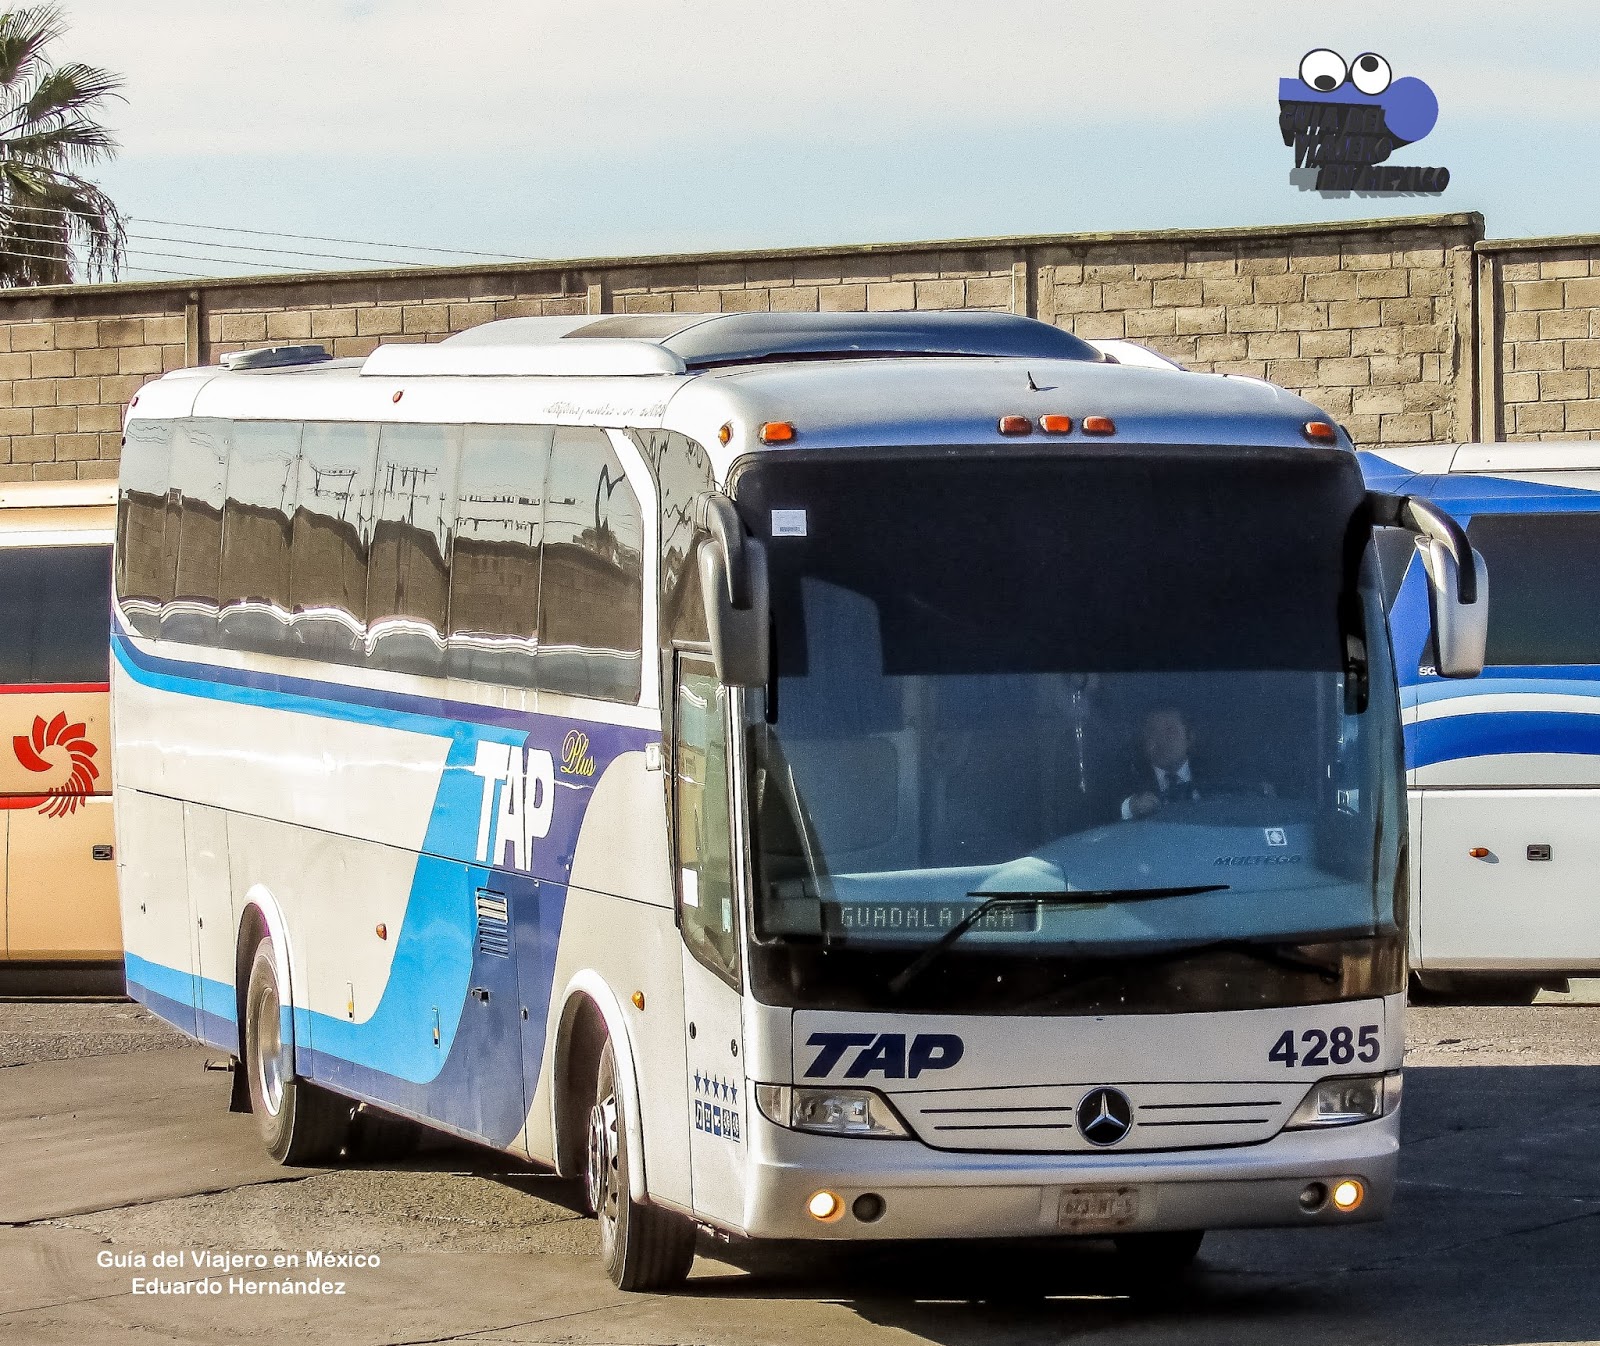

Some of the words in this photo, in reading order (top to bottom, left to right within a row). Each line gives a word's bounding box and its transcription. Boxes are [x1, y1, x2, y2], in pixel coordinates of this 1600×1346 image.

[560, 729, 597, 776] Plus
[474, 739, 556, 872] TAP
[803, 1032, 965, 1079] TAP
[1268, 1025, 1381, 1068] 4285
